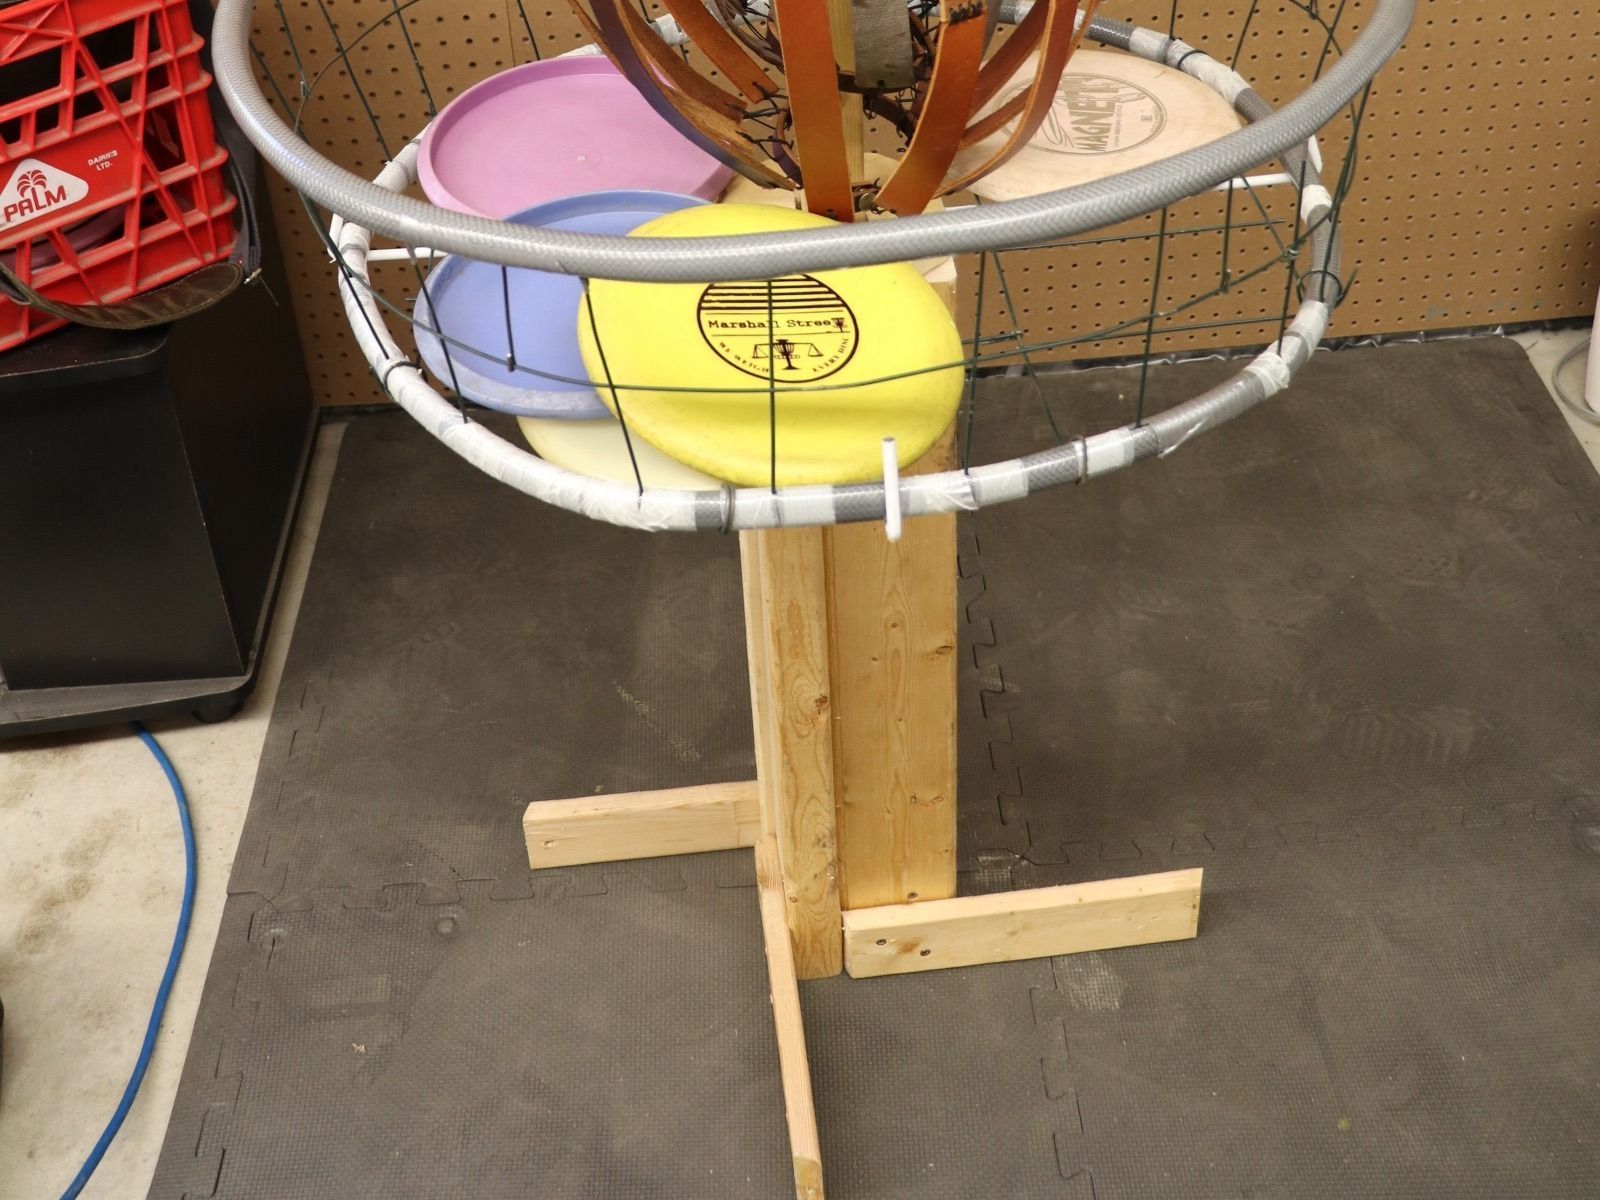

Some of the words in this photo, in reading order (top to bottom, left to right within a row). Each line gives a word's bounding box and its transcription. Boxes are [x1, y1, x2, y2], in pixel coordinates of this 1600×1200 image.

[87, 150, 118, 166] DAIRIES
[96, 161, 113, 171] LTD.
[4, 185, 67, 222] PALM
